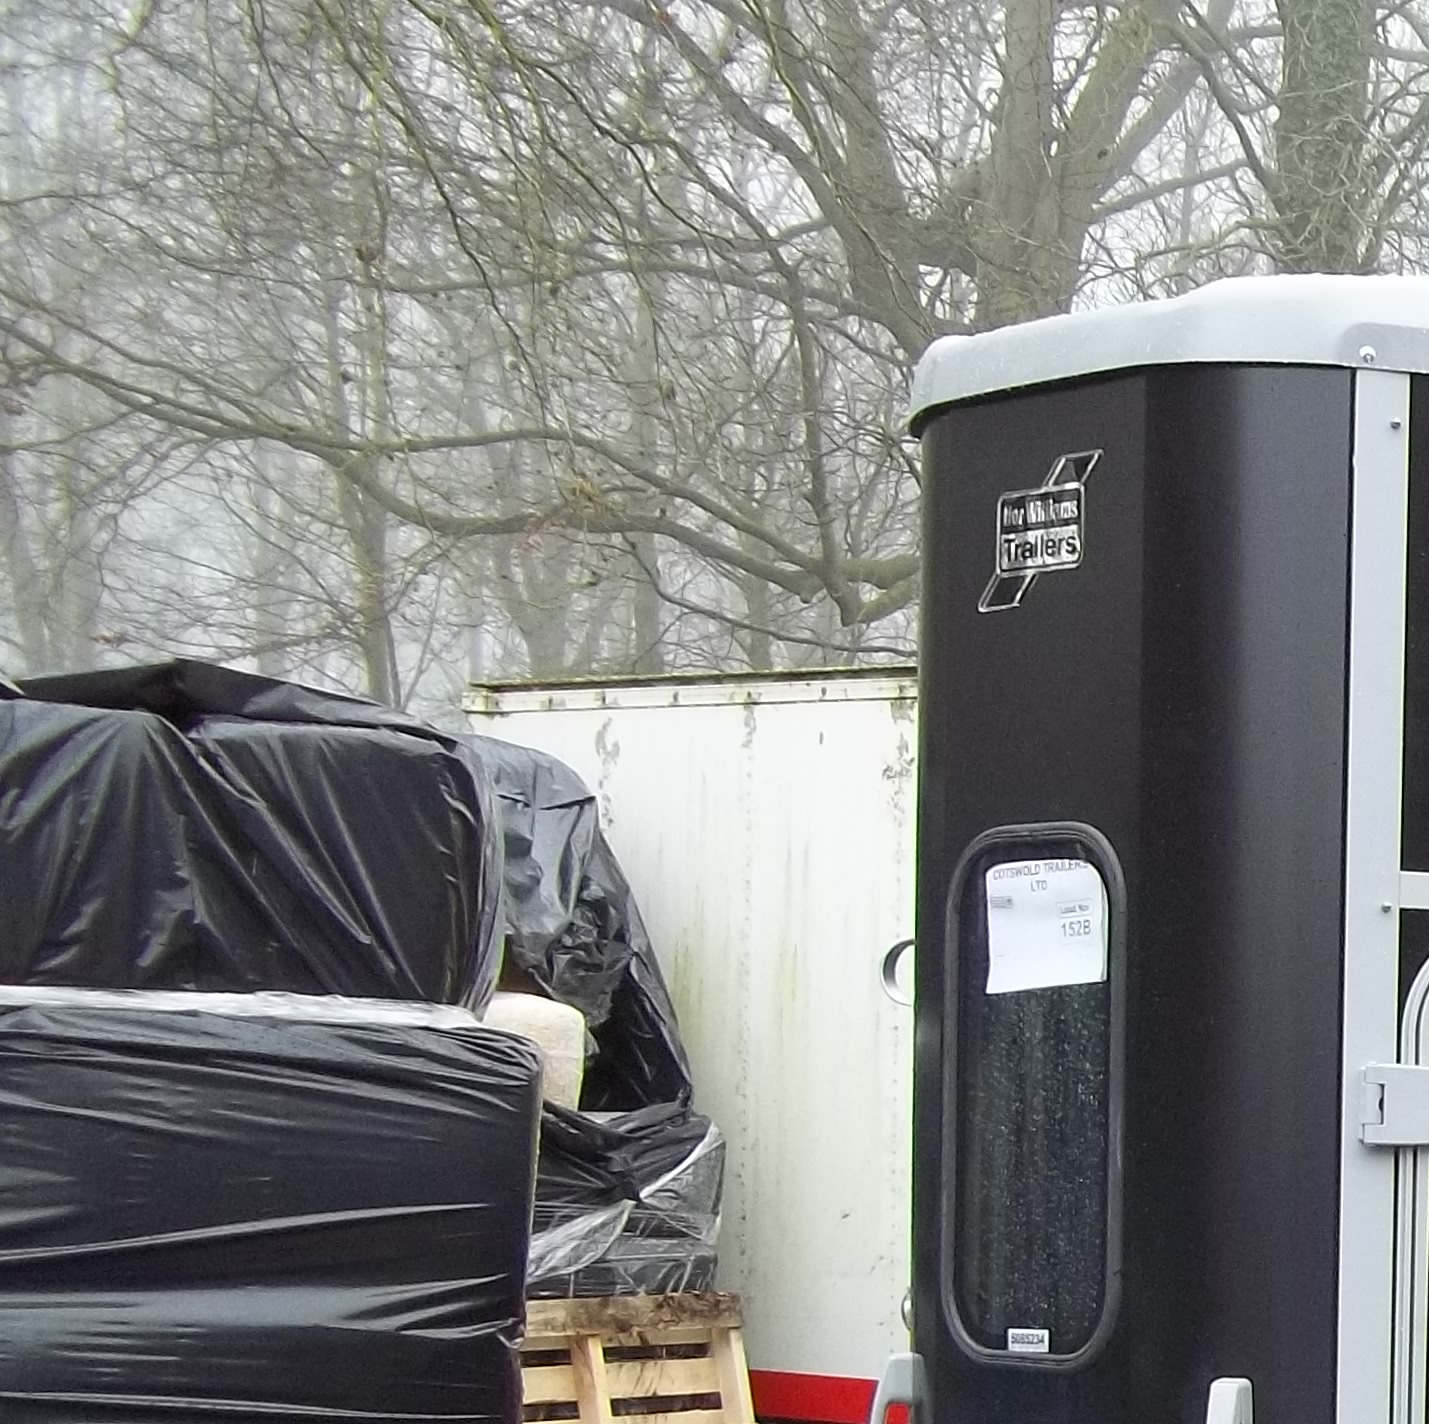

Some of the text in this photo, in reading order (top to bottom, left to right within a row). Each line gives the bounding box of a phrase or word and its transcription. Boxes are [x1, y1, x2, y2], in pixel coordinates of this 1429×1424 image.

[1003, 533, 1079, 562] Trailers
[993, 863, 1041, 880] COTSWOLD
[1030, 880, 1048, 892] LTD
